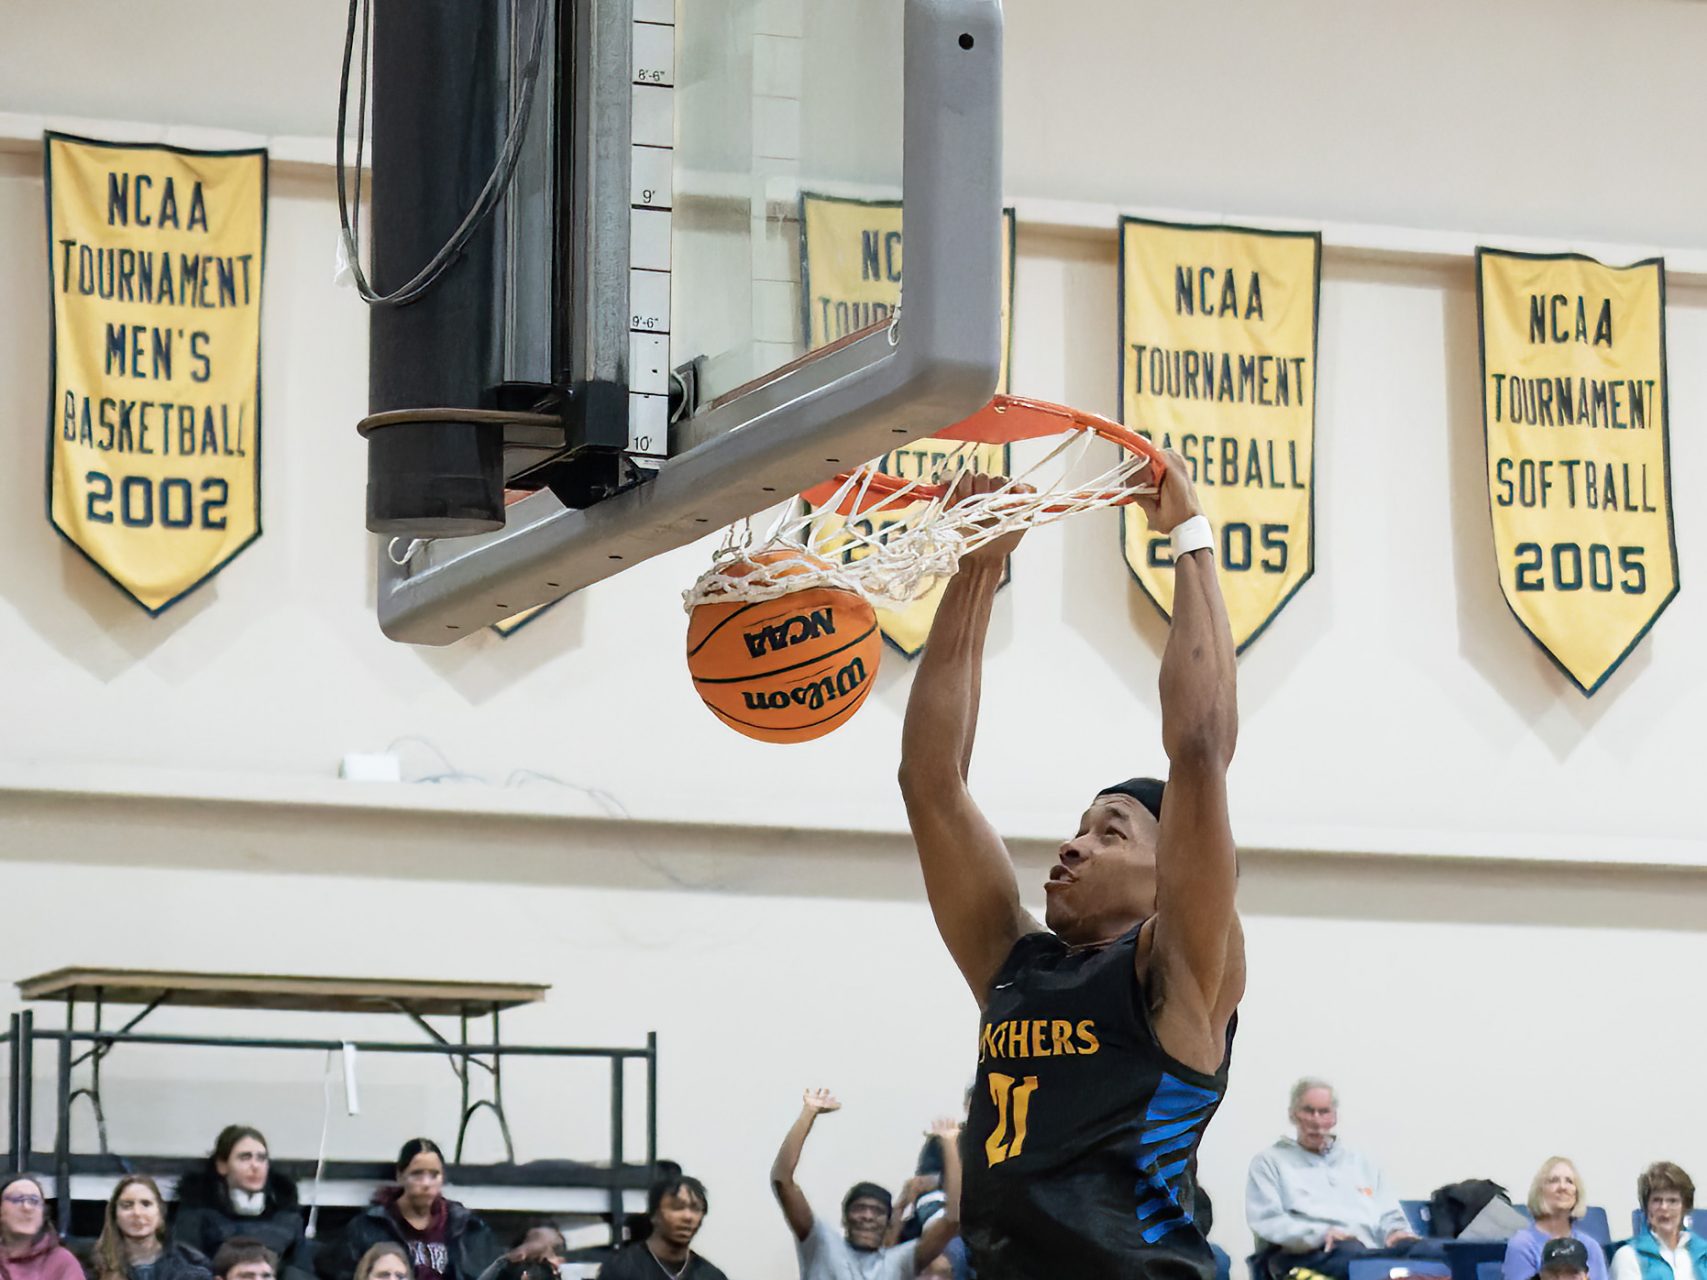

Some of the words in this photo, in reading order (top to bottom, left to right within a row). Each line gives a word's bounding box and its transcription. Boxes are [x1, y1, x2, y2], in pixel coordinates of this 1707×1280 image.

[107, 172, 210, 233] NCAA
[59, 239, 253, 309] TOURNAMENT
[862, 229, 902, 282] NC
[1175, 265, 1264, 321] NCAA
[1529, 294, 1613, 349] NCAA
[104, 323, 211, 383] MEN'S
[1131, 344, 1306, 407] TOURNAMENT
[63, 389, 247, 458] BASKETBALL
[1491, 373, 1655, 430] TOURNAMENT
[85, 471, 229, 530] 2002
[1495, 456, 1657, 513] SOFTBALL
[1147, 521, 1289, 574] 205
[1514, 542, 1647, 595] 2005
[743, 607, 836, 659] NCAA
[741, 656, 868, 710] Wilson
